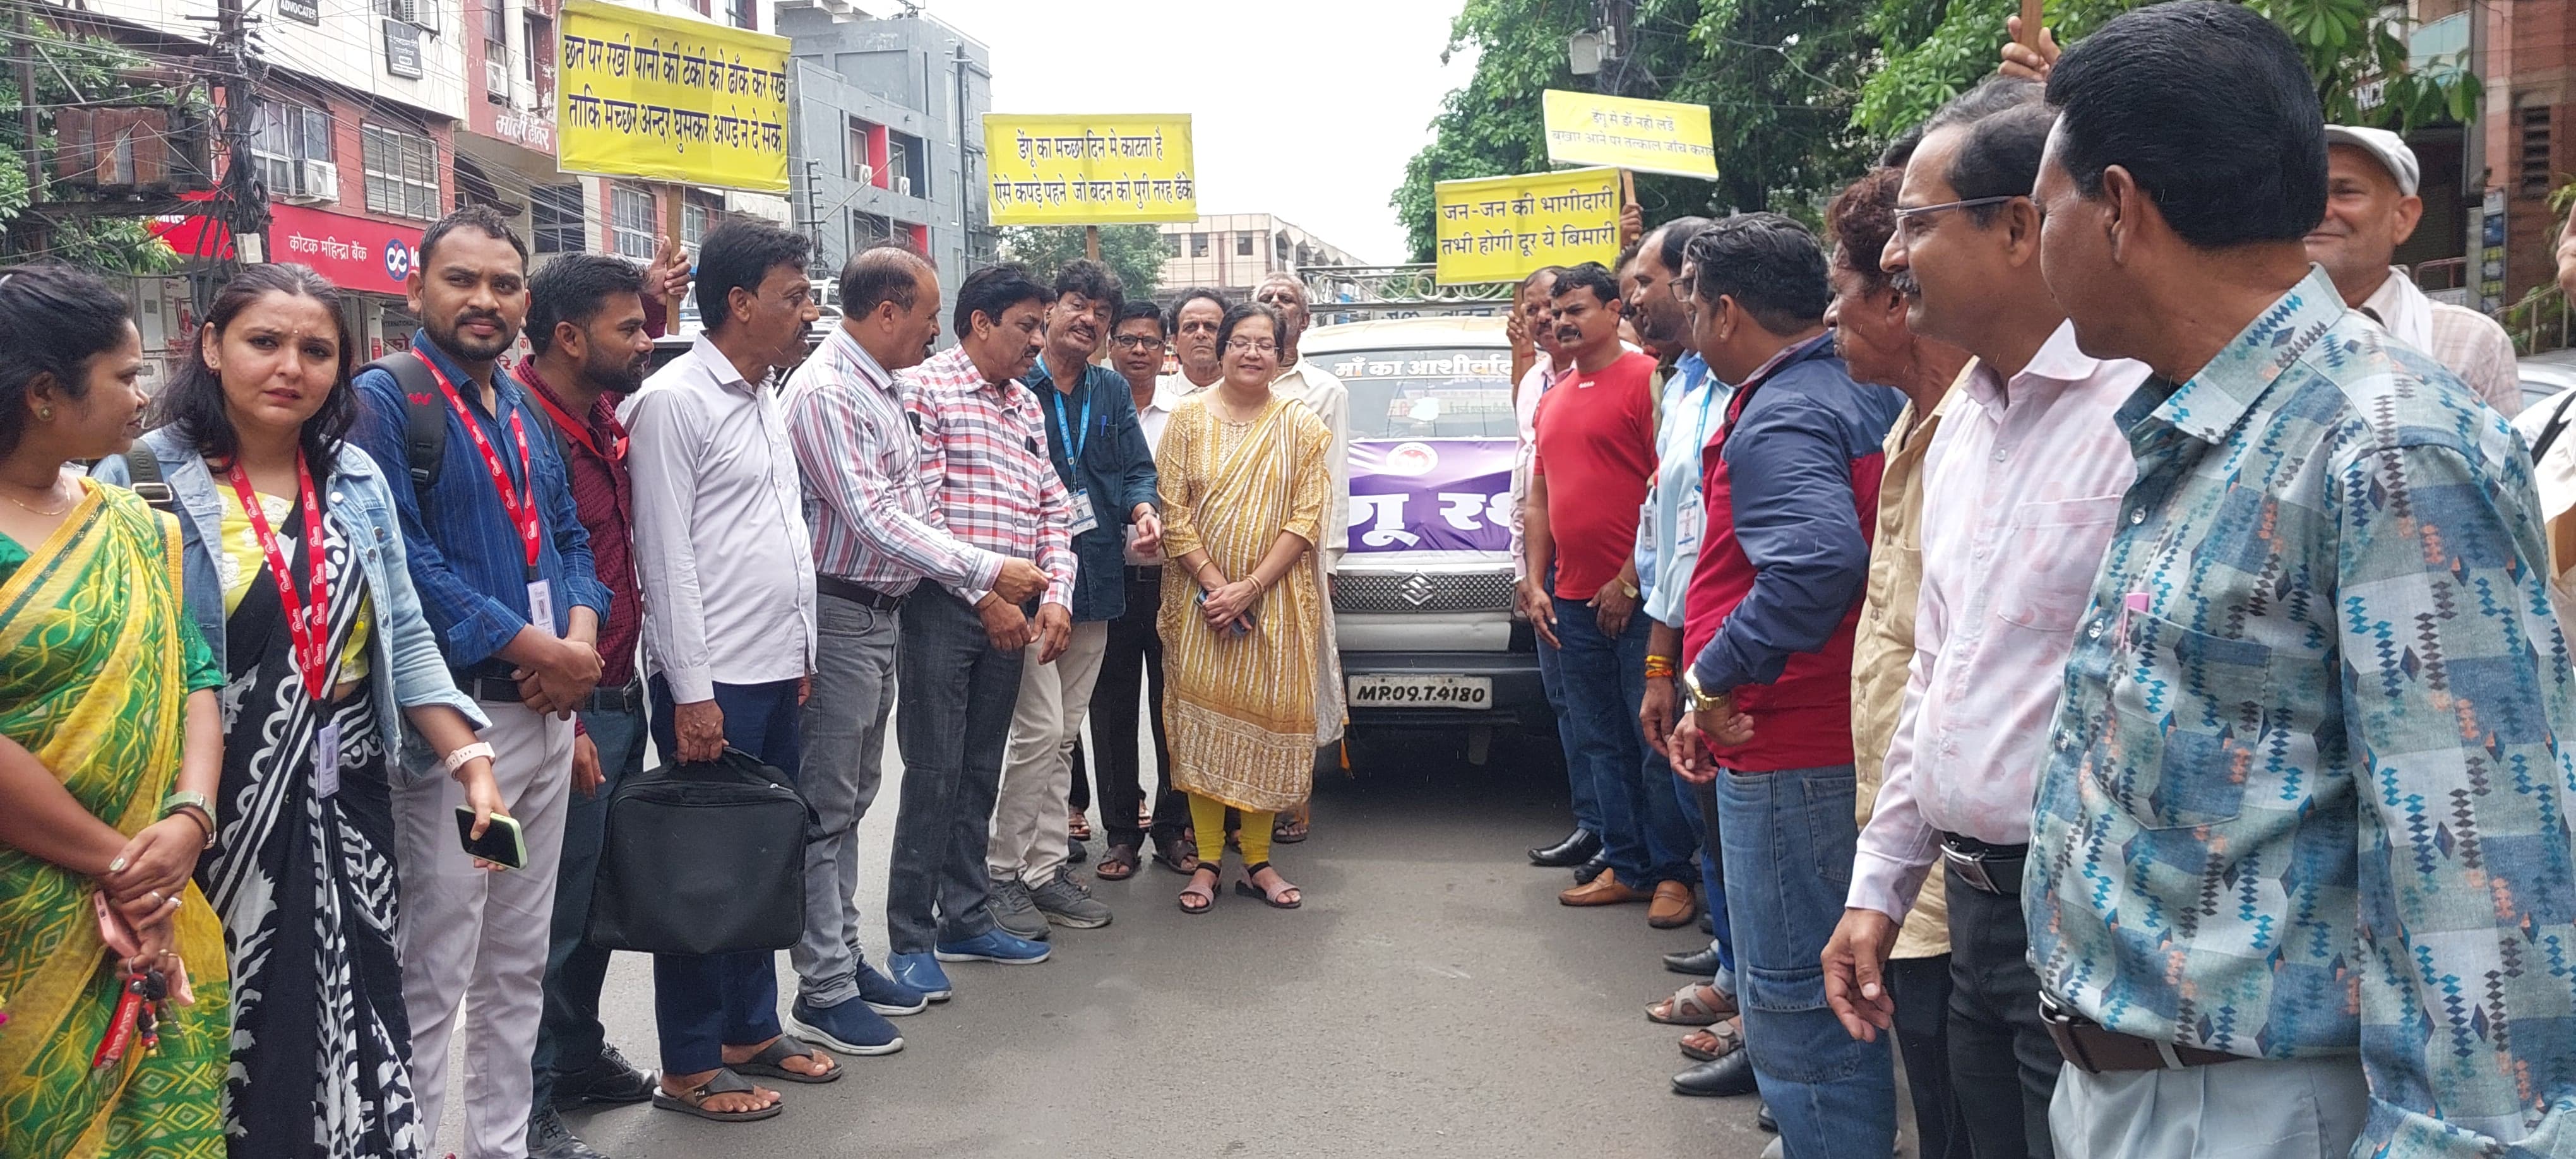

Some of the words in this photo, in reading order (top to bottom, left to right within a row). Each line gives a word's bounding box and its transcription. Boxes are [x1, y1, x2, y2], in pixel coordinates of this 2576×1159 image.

[281, 0, 317, 20] ADVOCATES
[564, 35, 586, 71] छत
[588, 39, 604, 74] पर
[607, 33, 631, 77] रखी
[634, 38, 660, 82] पानी
[662, 42, 681, 85] की
[683, 44, 707, 90] टंकी
[708, 48, 725, 92] को
[751, 68, 768, 100] कर
[568, 83, 601, 131] ताकि
[603, 99, 638, 135] मच्छर
[640, 104, 671, 144] अन्दर
[673, 109, 709, 153] घुसकर
[712, 104, 739, 148] अण्डे
[740, 119, 748, 149] न
[751, 107, 759, 157] दे
[761, 110, 782, 153] सके
[1017, 129, 1037, 167] डेंगू
[1035, 138, 1051, 158] का
[1054, 138, 1085, 158] मच्छर
[1085, 129, 1105, 162] दिन
[1109, 128, 1118, 157] मे
[1120, 137, 1152, 158] काटता
[1154, 126, 1162, 161] है
[993, 173, 1011, 210] ऐसे
[1013, 173, 1042, 209] कपड़े
[1043, 173, 1066, 206] पहने
[1072, 173, 1087, 202] जो
[1088, 181, 1113, 205] बदन
[1115, 172, 1131, 201] को
[1133, 173, 1150, 209] पुरी
[1152, 181, 1172, 204] तरह
[1511, 192, 1535, 216] की
[1541, 185, 1613, 213] भागीदारी
[288, 231, 319, 255] कोटक
[320, 236, 349, 260] महिन्द्रा
[351, 241, 367, 261] बैंक
[1441, 232, 1473, 255] तभी
[1477, 229, 1513, 256] होगी
[1517, 234, 1537, 257] दूर
[1542, 225, 1555, 247] ये
[1560, 221, 1615, 247] बिमारी
[1334, 355, 1366, 377] माँ
[1368, 360, 1404, 376] का
